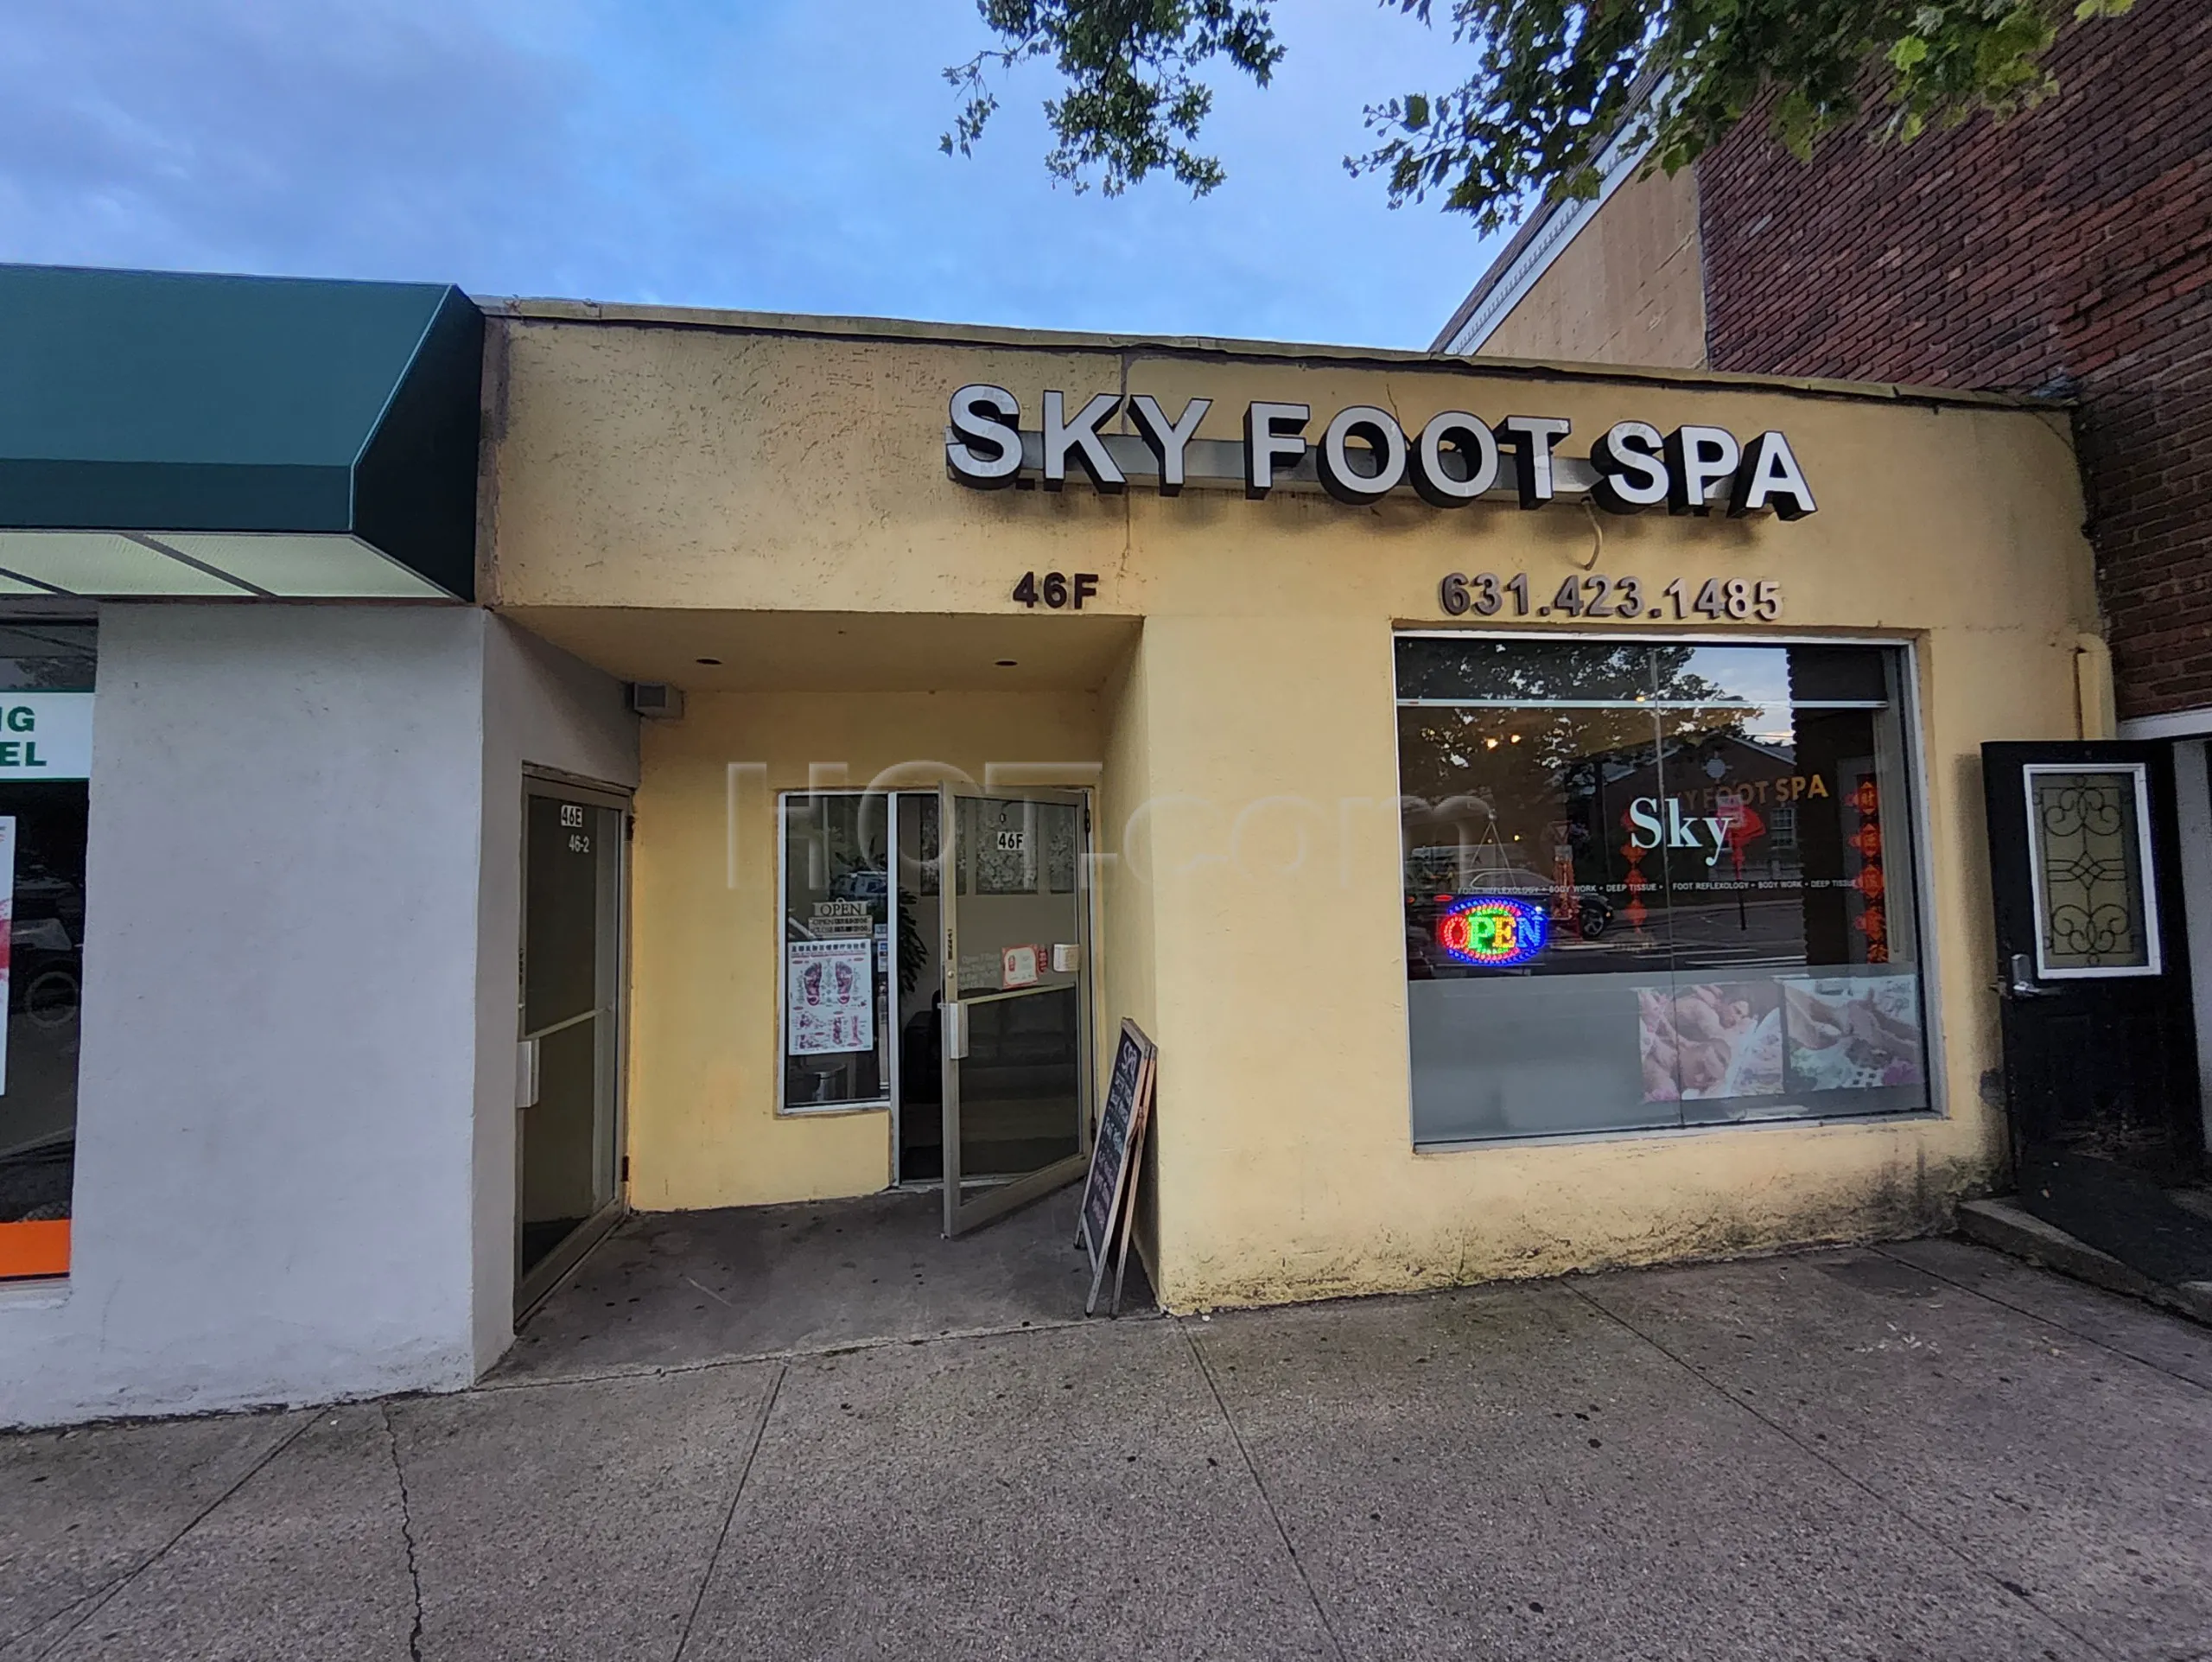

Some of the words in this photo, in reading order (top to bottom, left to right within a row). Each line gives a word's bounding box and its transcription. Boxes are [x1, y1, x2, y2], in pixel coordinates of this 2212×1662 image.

[949, 383, 1212, 496] SKY
[1244, 401, 1571, 510] FOOT
[1591, 421, 1818, 519] SPA
[1013, 571, 1099, 609] 46F
[1440, 572, 1784, 621] 631.423.1485
[0, 706, 35, 732] G
[1775, 774, 1829, 802] SPA
[562, 806, 582, 825] 46E
[569, 834, 589, 853] 46-2
[999, 832, 1023, 849] 46F
[1630, 797, 1733, 865] Sky
[1605, 883, 1627, 892] DEEP
[1629, 882, 1656, 891] TISSUE
[1695, 880, 1749, 890] REFLEXOLOGY
[1780, 880, 1802, 888] WORK
[820, 903, 861, 916] OPEN
[1443, 914, 1545, 950] OPEN
